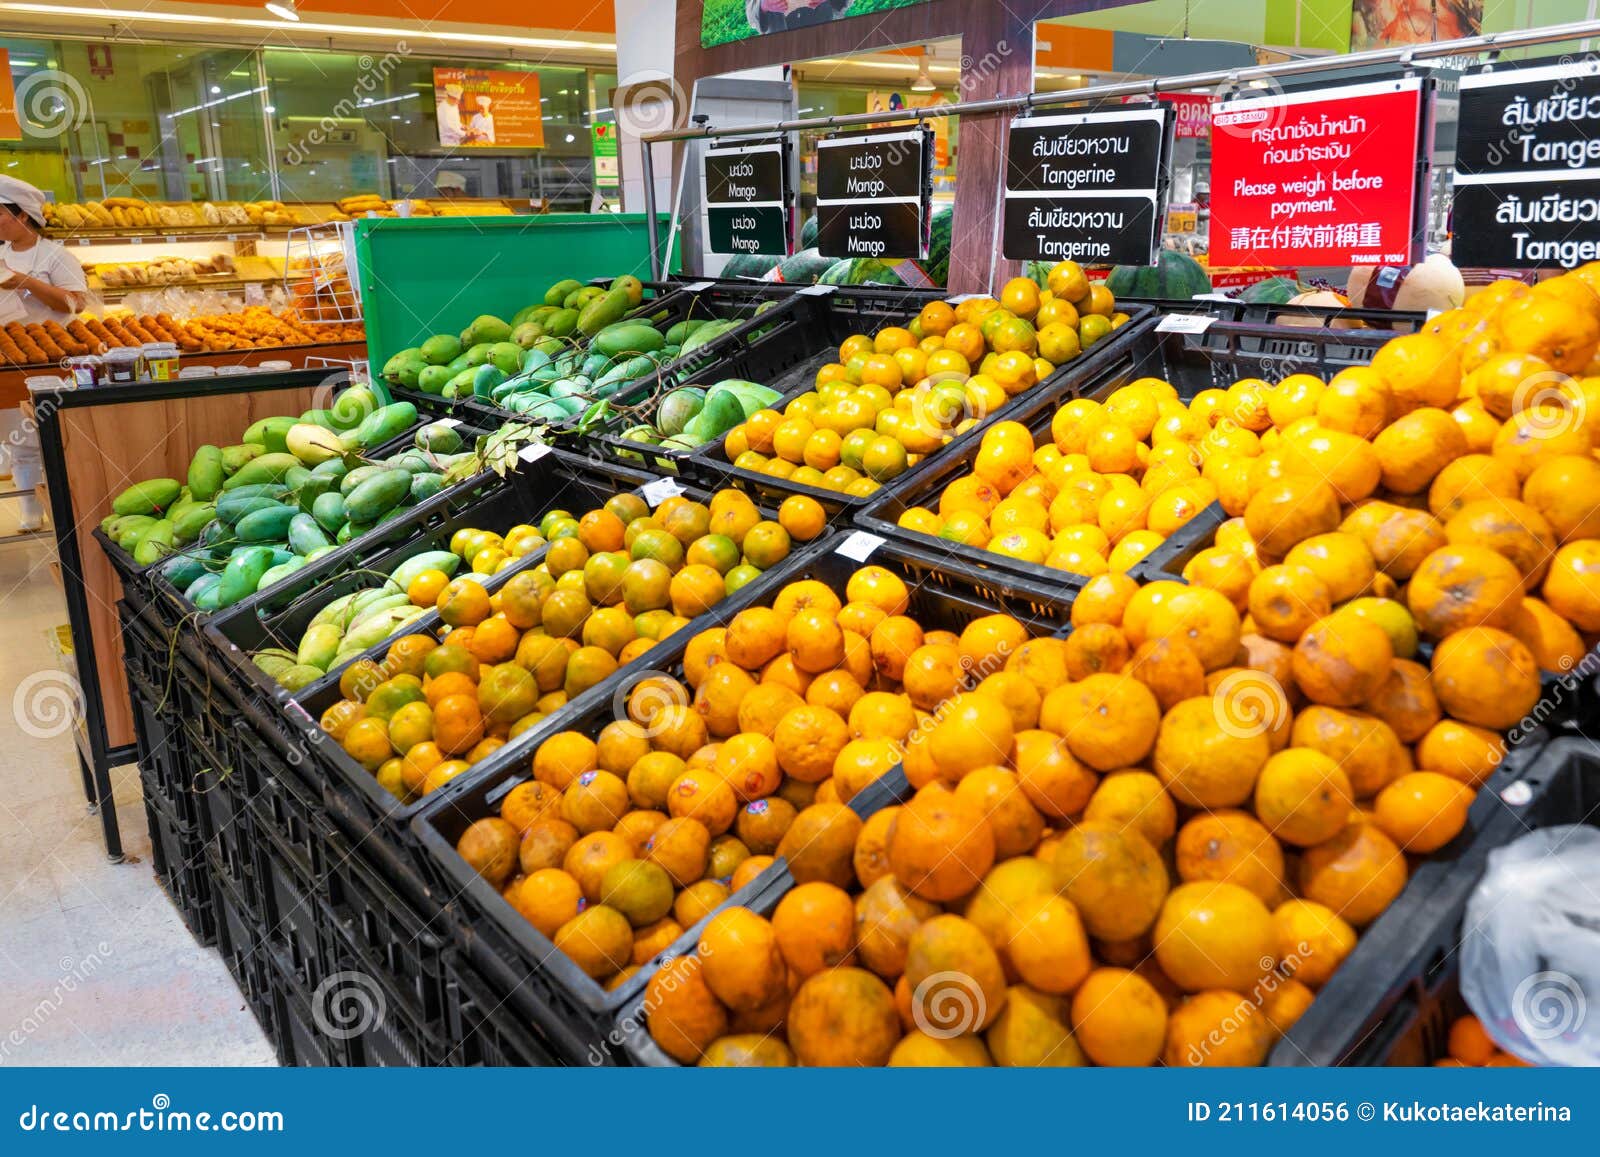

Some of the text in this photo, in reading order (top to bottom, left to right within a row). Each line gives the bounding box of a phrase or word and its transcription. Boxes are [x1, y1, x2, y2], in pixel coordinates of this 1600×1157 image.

[1252, 114, 1366, 145] กรุณาชั่งน้ำหนัก
[1032, 135, 1130, 157] ส้มเขียวหวาน
[1263, 142, 1351, 164] ก่อนชำระเงิน
[729, 160, 753, 177] มะม่วง
[850, 151, 882, 169] มะม่วง
[1041, 163, 1116, 189] Tangerine
[1234, 169, 1383, 197] Please weigh before
[728, 183, 756, 201] Mango
[847, 178, 884, 197] Mango
[1028, 207, 1123, 229] ส้มเขียวหวาน
[1271, 197, 1337, 219] payment.
[732, 213, 756, 229] มะม่วง
[850, 211, 882, 229] มะม่วง
[732, 235, 759, 253] Mango
[848, 235, 885, 256] Mango
[1230, 222, 1382, 250] 請在付款前稱重
[1037, 235, 1111, 260] Tangerine
[1351, 253, 1405, 263] THANK YOU
